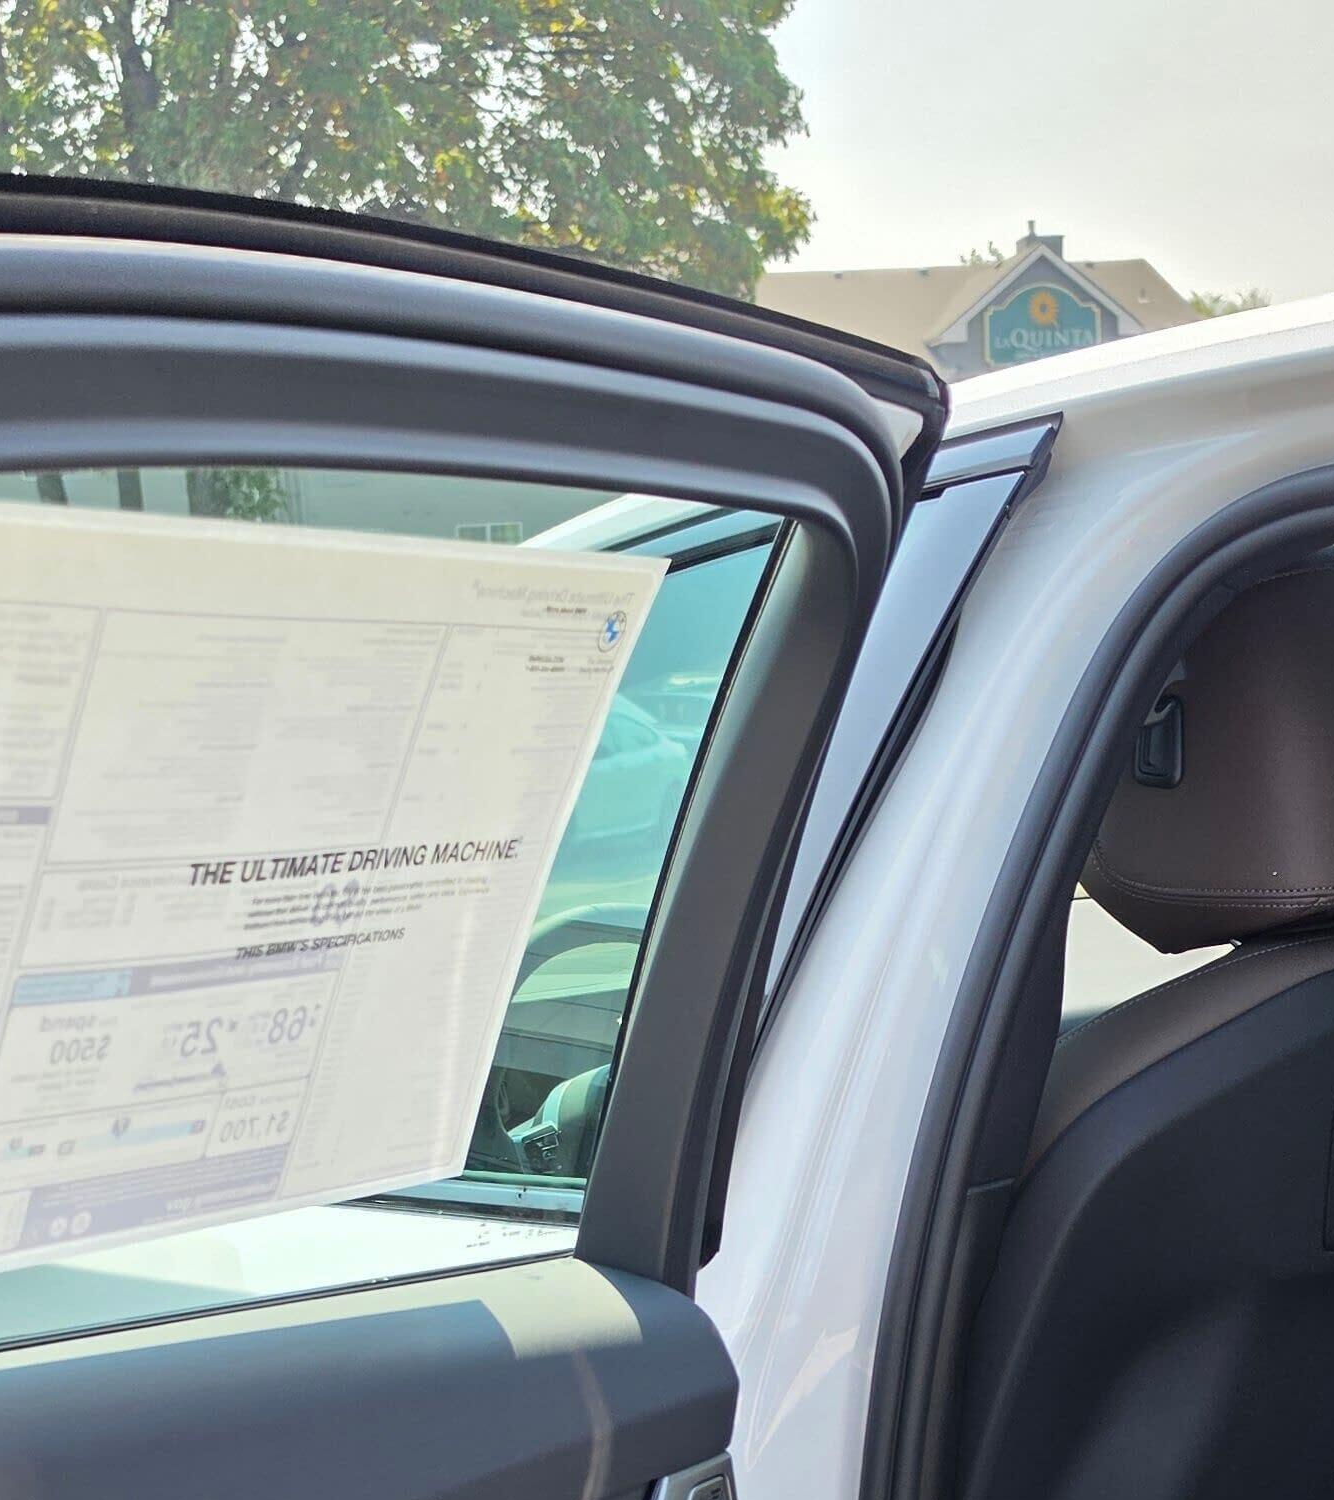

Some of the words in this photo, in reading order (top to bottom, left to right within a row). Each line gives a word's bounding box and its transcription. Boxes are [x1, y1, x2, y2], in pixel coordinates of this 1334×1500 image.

[1010, 327, 1094, 351] QUINTA
[190, 861, 236, 886] THE
[240, 852, 346, 883] ULTIMATE
[347, 844, 427, 872] DRIVING
[235, 943, 264, 961] THIS
[310, 926, 406, 951] SPECIFICATIONS
